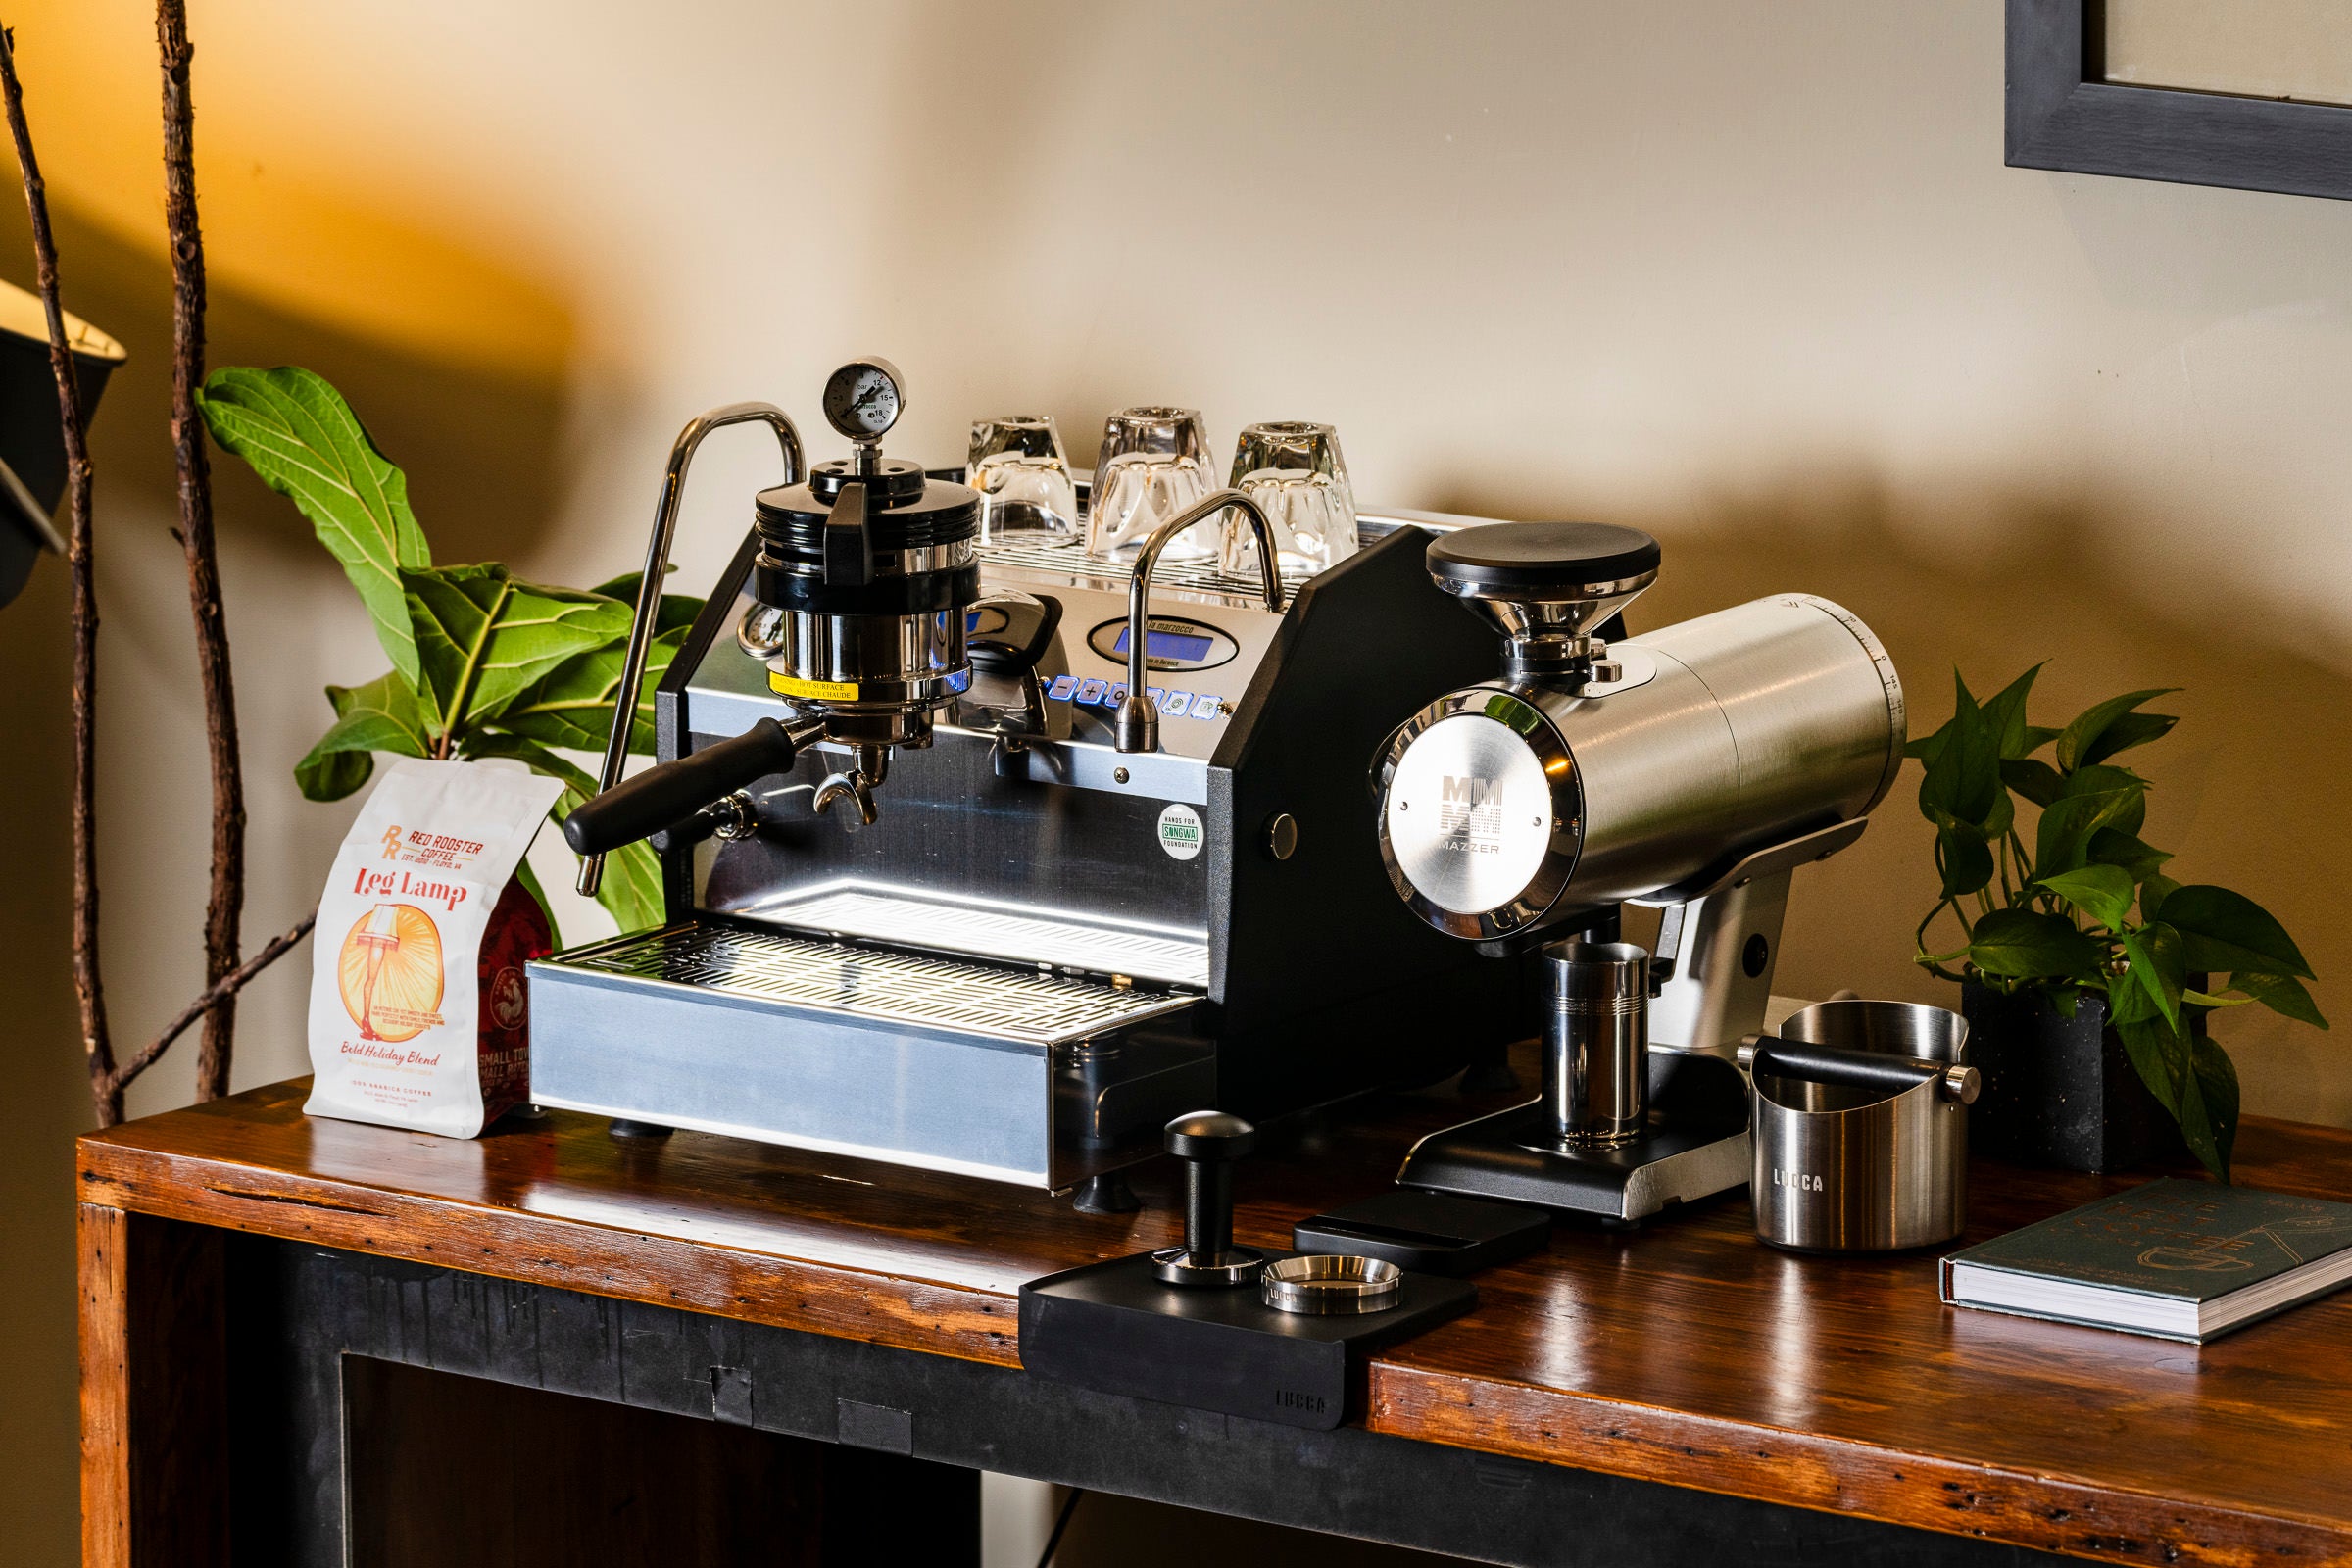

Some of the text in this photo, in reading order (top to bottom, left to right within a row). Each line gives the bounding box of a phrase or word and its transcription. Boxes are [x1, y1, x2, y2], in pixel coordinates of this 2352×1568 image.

[1149, 620, 1194, 634] la marzocco
[812, 683, 845, 692] SURFACE
[1889, 674, 1898, 690] 145
[822, 690, 852, 699] CHAUDE
[1165, 826, 1196, 839] SONGWA
[408, 830, 484, 855] RED ROOSTER
[1439, 840, 1499, 854] MAZZER
[420, 848, 457, 861] COFFEE
[353, 867, 467, 912] Leg Lamp
[340, 1041, 441, 1066] Bold Holiday Blend
[478, 1050, 512, 1068] SMALL
[2074, 1216, 2255, 1251] COFFEE
[1270, 1288, 1298, 1303] LUCCA
[1276, 1389, 1326, 1414] LUCCA
